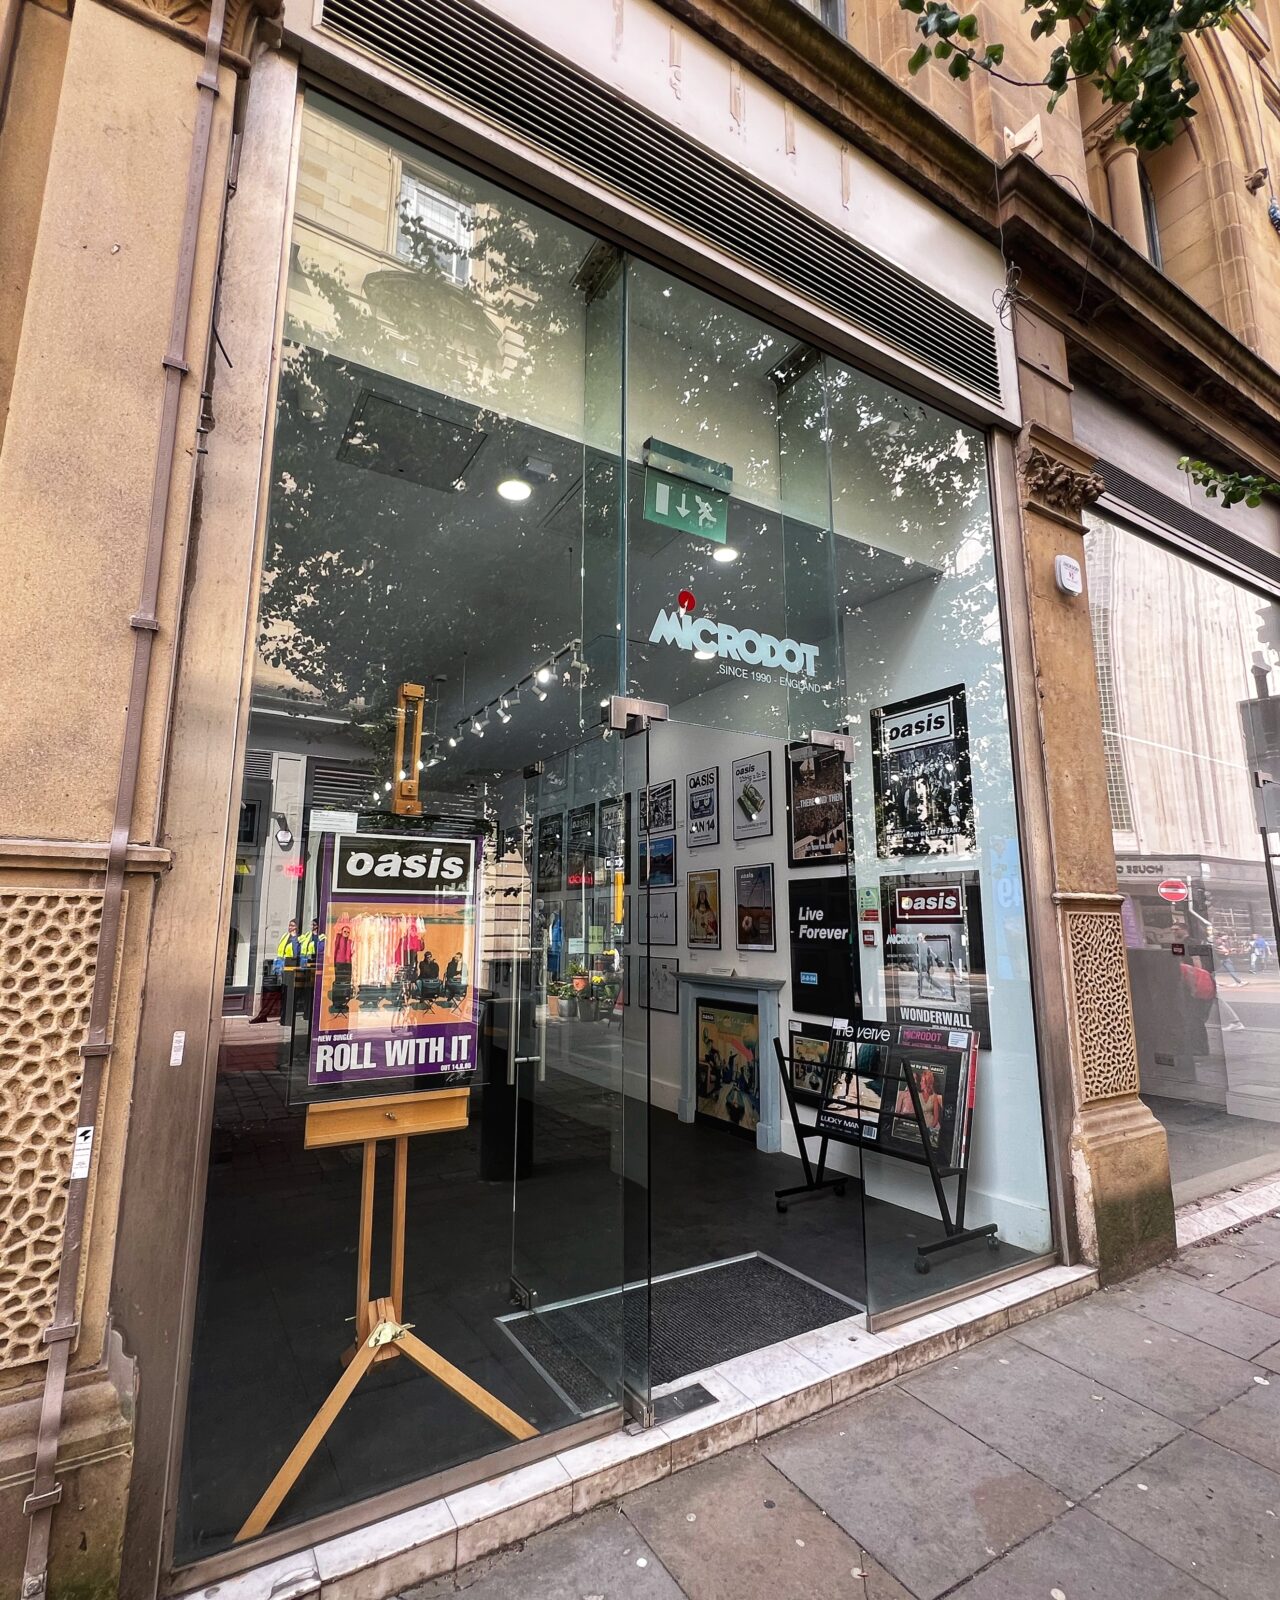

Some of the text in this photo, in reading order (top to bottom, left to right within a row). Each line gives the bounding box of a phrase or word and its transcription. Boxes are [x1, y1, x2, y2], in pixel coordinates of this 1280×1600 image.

[649, 590, 819, 677] MICRODOT
[719, 664, 749, 679] SINCE
[751, 671, 772, 684] 1990
[780, 677, 821, 693] ENGLAND
[889, 713, 945, 741] oasis
[736, 764, 755, 776] oasis
[689, 773, 714, 789] OASIS
[800, 798, 815, 808] THERE
[815, 795, 828, 804] ND
[690, 819, 715, 834] JAN 14
[346, 848, 464, 880] oasis
[901, 892, 957, 910] oasis
[799, 906, 824, 921] Live
[799, 924, 849, 940] Forever
[900, 1007, 973, 1029] WONDERWALL
[333, 1033, 353, 1041] SINGLE
[857, 1026, 891, 1041] verve
[903, 1030, 942, 1043] MICRODOT
[316, 1035, 471, 1073] ROLL WITH IT
[440, 1064, 451, 1072] OUT
[820, 1115, 843, 1125] LUCKY
